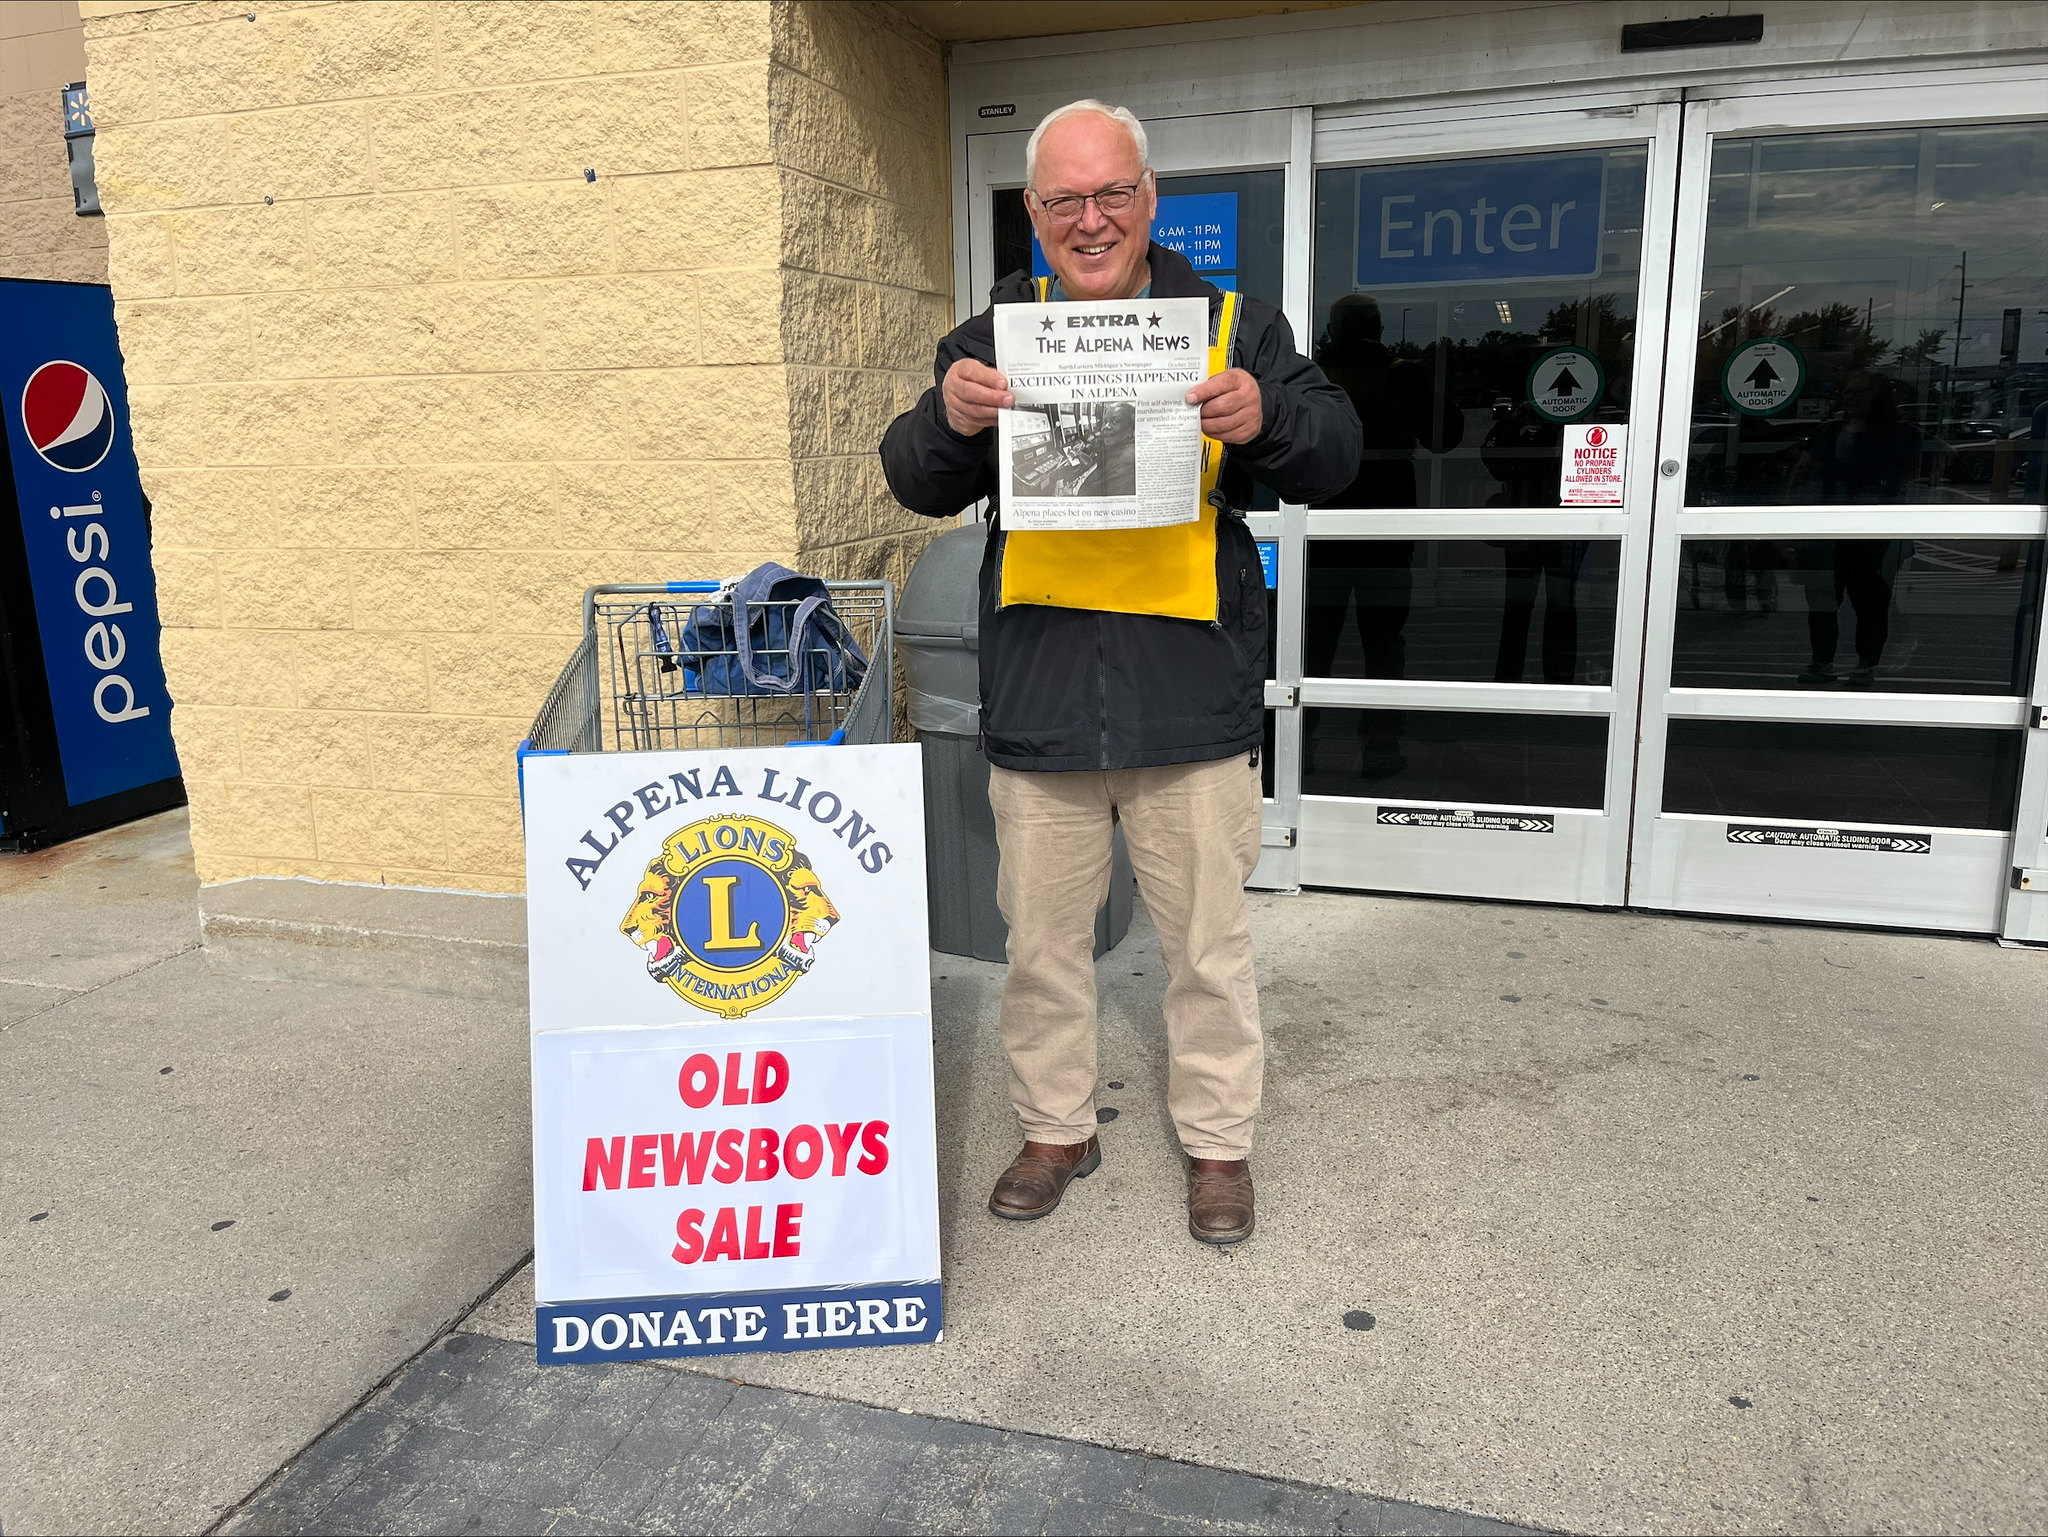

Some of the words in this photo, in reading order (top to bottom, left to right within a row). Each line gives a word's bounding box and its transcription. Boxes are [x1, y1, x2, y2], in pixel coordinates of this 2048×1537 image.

[981, 106, 1013, 116] STANLEY
[1158, 226, 1165, 238] 6
[1167, 226, 1185, 236] AM
[1194, 225, 1202, 235] 11
[1204, 224, 1221, 234] PM
[1379, 194, 1577, 260] Enter
[1167, 241, 1185, 251] AM
[1194, 240, 1202, 250] 11
[1204, 239, 1221, 250] PM
[1194, 255, 1202, 265] 11
[1204, 254, 1221, 265] PM
[1066, 313, 1140, 328] EXTRA
[1010, 375, 1071, 389] EXCITING
[1074, 373, 1122, 386] THINGS
[1124, 371, 1199, 384] HAPPENING
[1071, 388, 1085, 399] IN
[1087, 387, 1138, 398] ALPENA
[1736, 389, 1787, 399] AUTOMATIC
[1541, 397, 1588, 406] AUTOMATIC
[1748, 398, 1774, 406] DOOR
[1552, 405, 1576, 413] DOOR
[1574, 448, 1617, 459] NOTICE
[1585, 459, 1616, 467] PROPANE
[1576, 467, 1612, 475] CYLINDERS
[1012, 509, 1041, 519] Alpena
[1042, 509, 1067, 518] places
[1068, 508, 1080, 517] bet
[1110, 508, 1136, 516] casino
[49, 503, 151, 724] pepsi
[1440, 815, 1475, 823] AUTOMATIC
[565, 765, 743, 891] ALPENA
[757, 767, 894, 875] LIONS
[1485, 823, 1509, 831] warning
[1765, 831, 1797, 839] CAUTION:
[1799, 833, 1840, 842] AUTOMATIC
[1841, 835, 1870, 844] SLIDING
[1870, 837, 1891, 845] DOOR
[675, 825, 787, 864] LIONS
[1806, 839, 1824, 847] close
[1852, 843, 1879, 851] warning
[701, 875, 765, 952] L
[665, 954, 801, 1000] INTERNATIONAL
[677, 1049, 790, 1110] OLD
[581, 1119, 891, 1192] NEWSBOYS
[671, 1202, 804, 1265] SALE
[551, 1304, 768, 1354] DONATE
[782, 1296, 928, 1341] HERE
